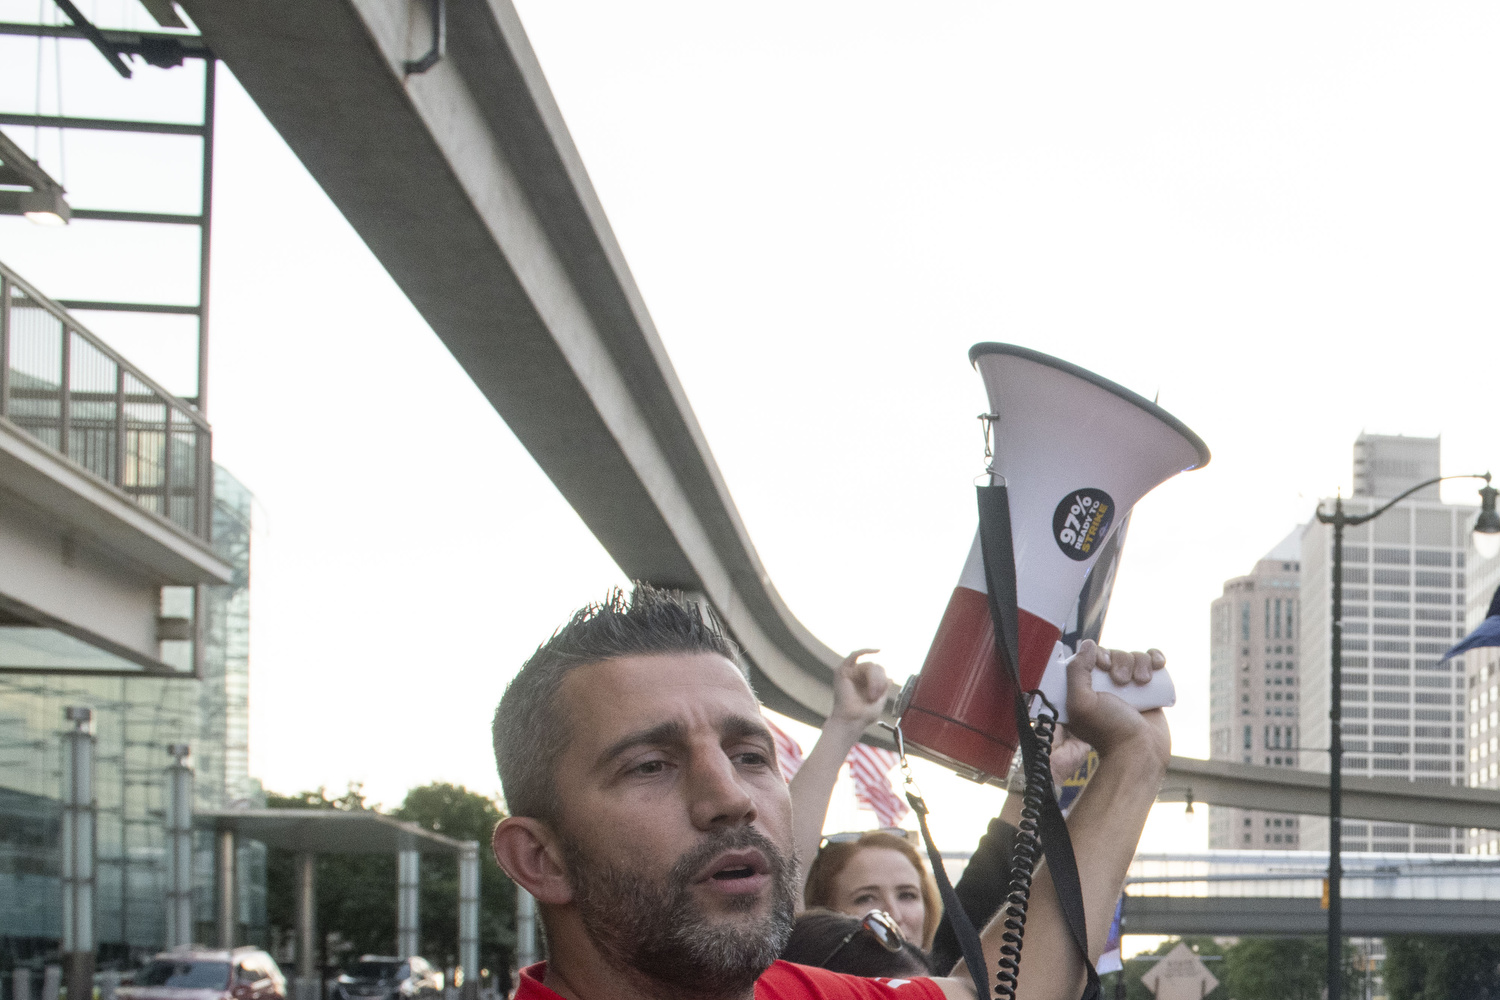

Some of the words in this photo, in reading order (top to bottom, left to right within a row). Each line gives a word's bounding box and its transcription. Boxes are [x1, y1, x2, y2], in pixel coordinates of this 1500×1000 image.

[1060, 495, 1092, 546] 97%
[1074, 515, 1093, 550] READY
[1088, 500, 1100, 514] TO
[1081, 503, 1109, 553] STRIKE
